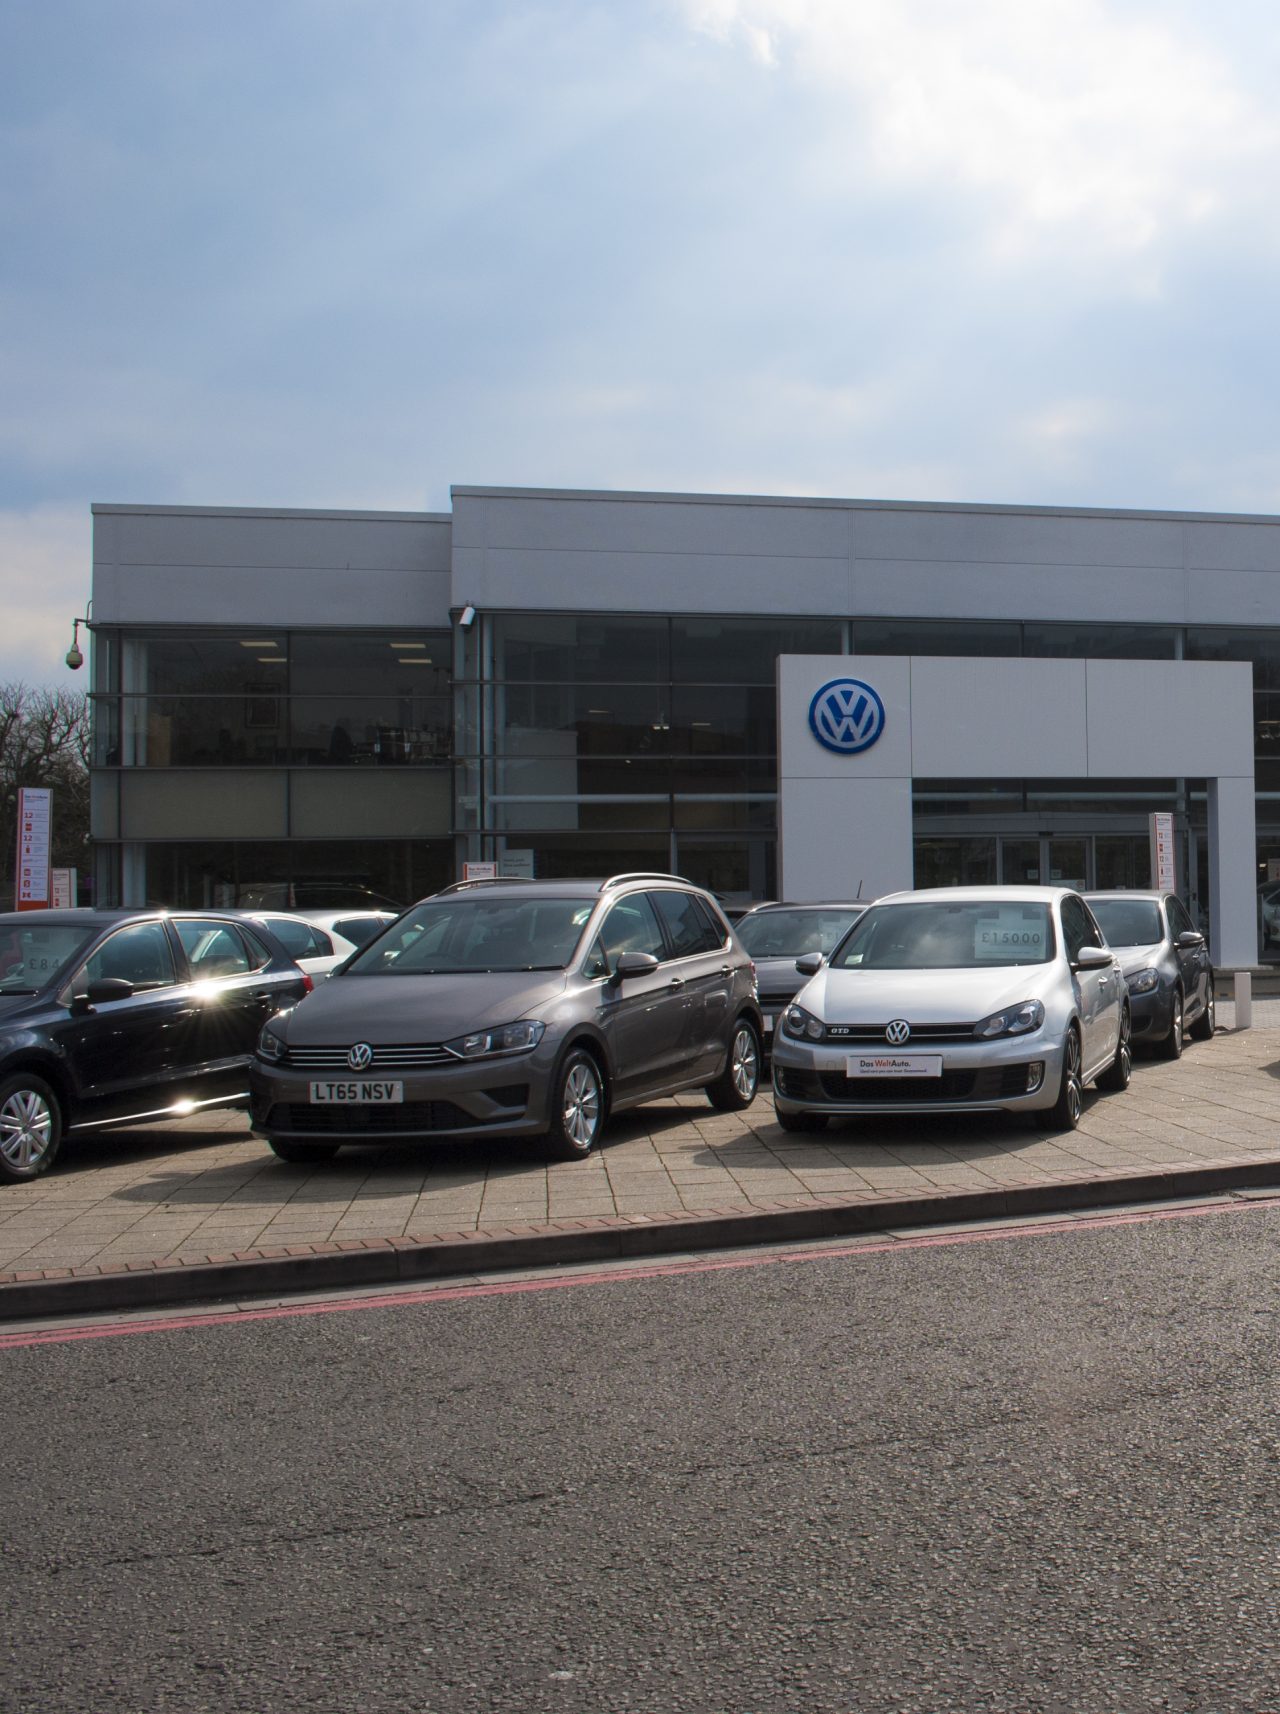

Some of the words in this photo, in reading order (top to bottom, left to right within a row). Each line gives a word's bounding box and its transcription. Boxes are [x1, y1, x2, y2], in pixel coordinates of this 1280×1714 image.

[982, 932, 1040, 944] £15000
[860, 1060, 874, 1068] Das
[315, 1084, 358, 1100] LT65
[362, 1083, 394, 1100] NSV
